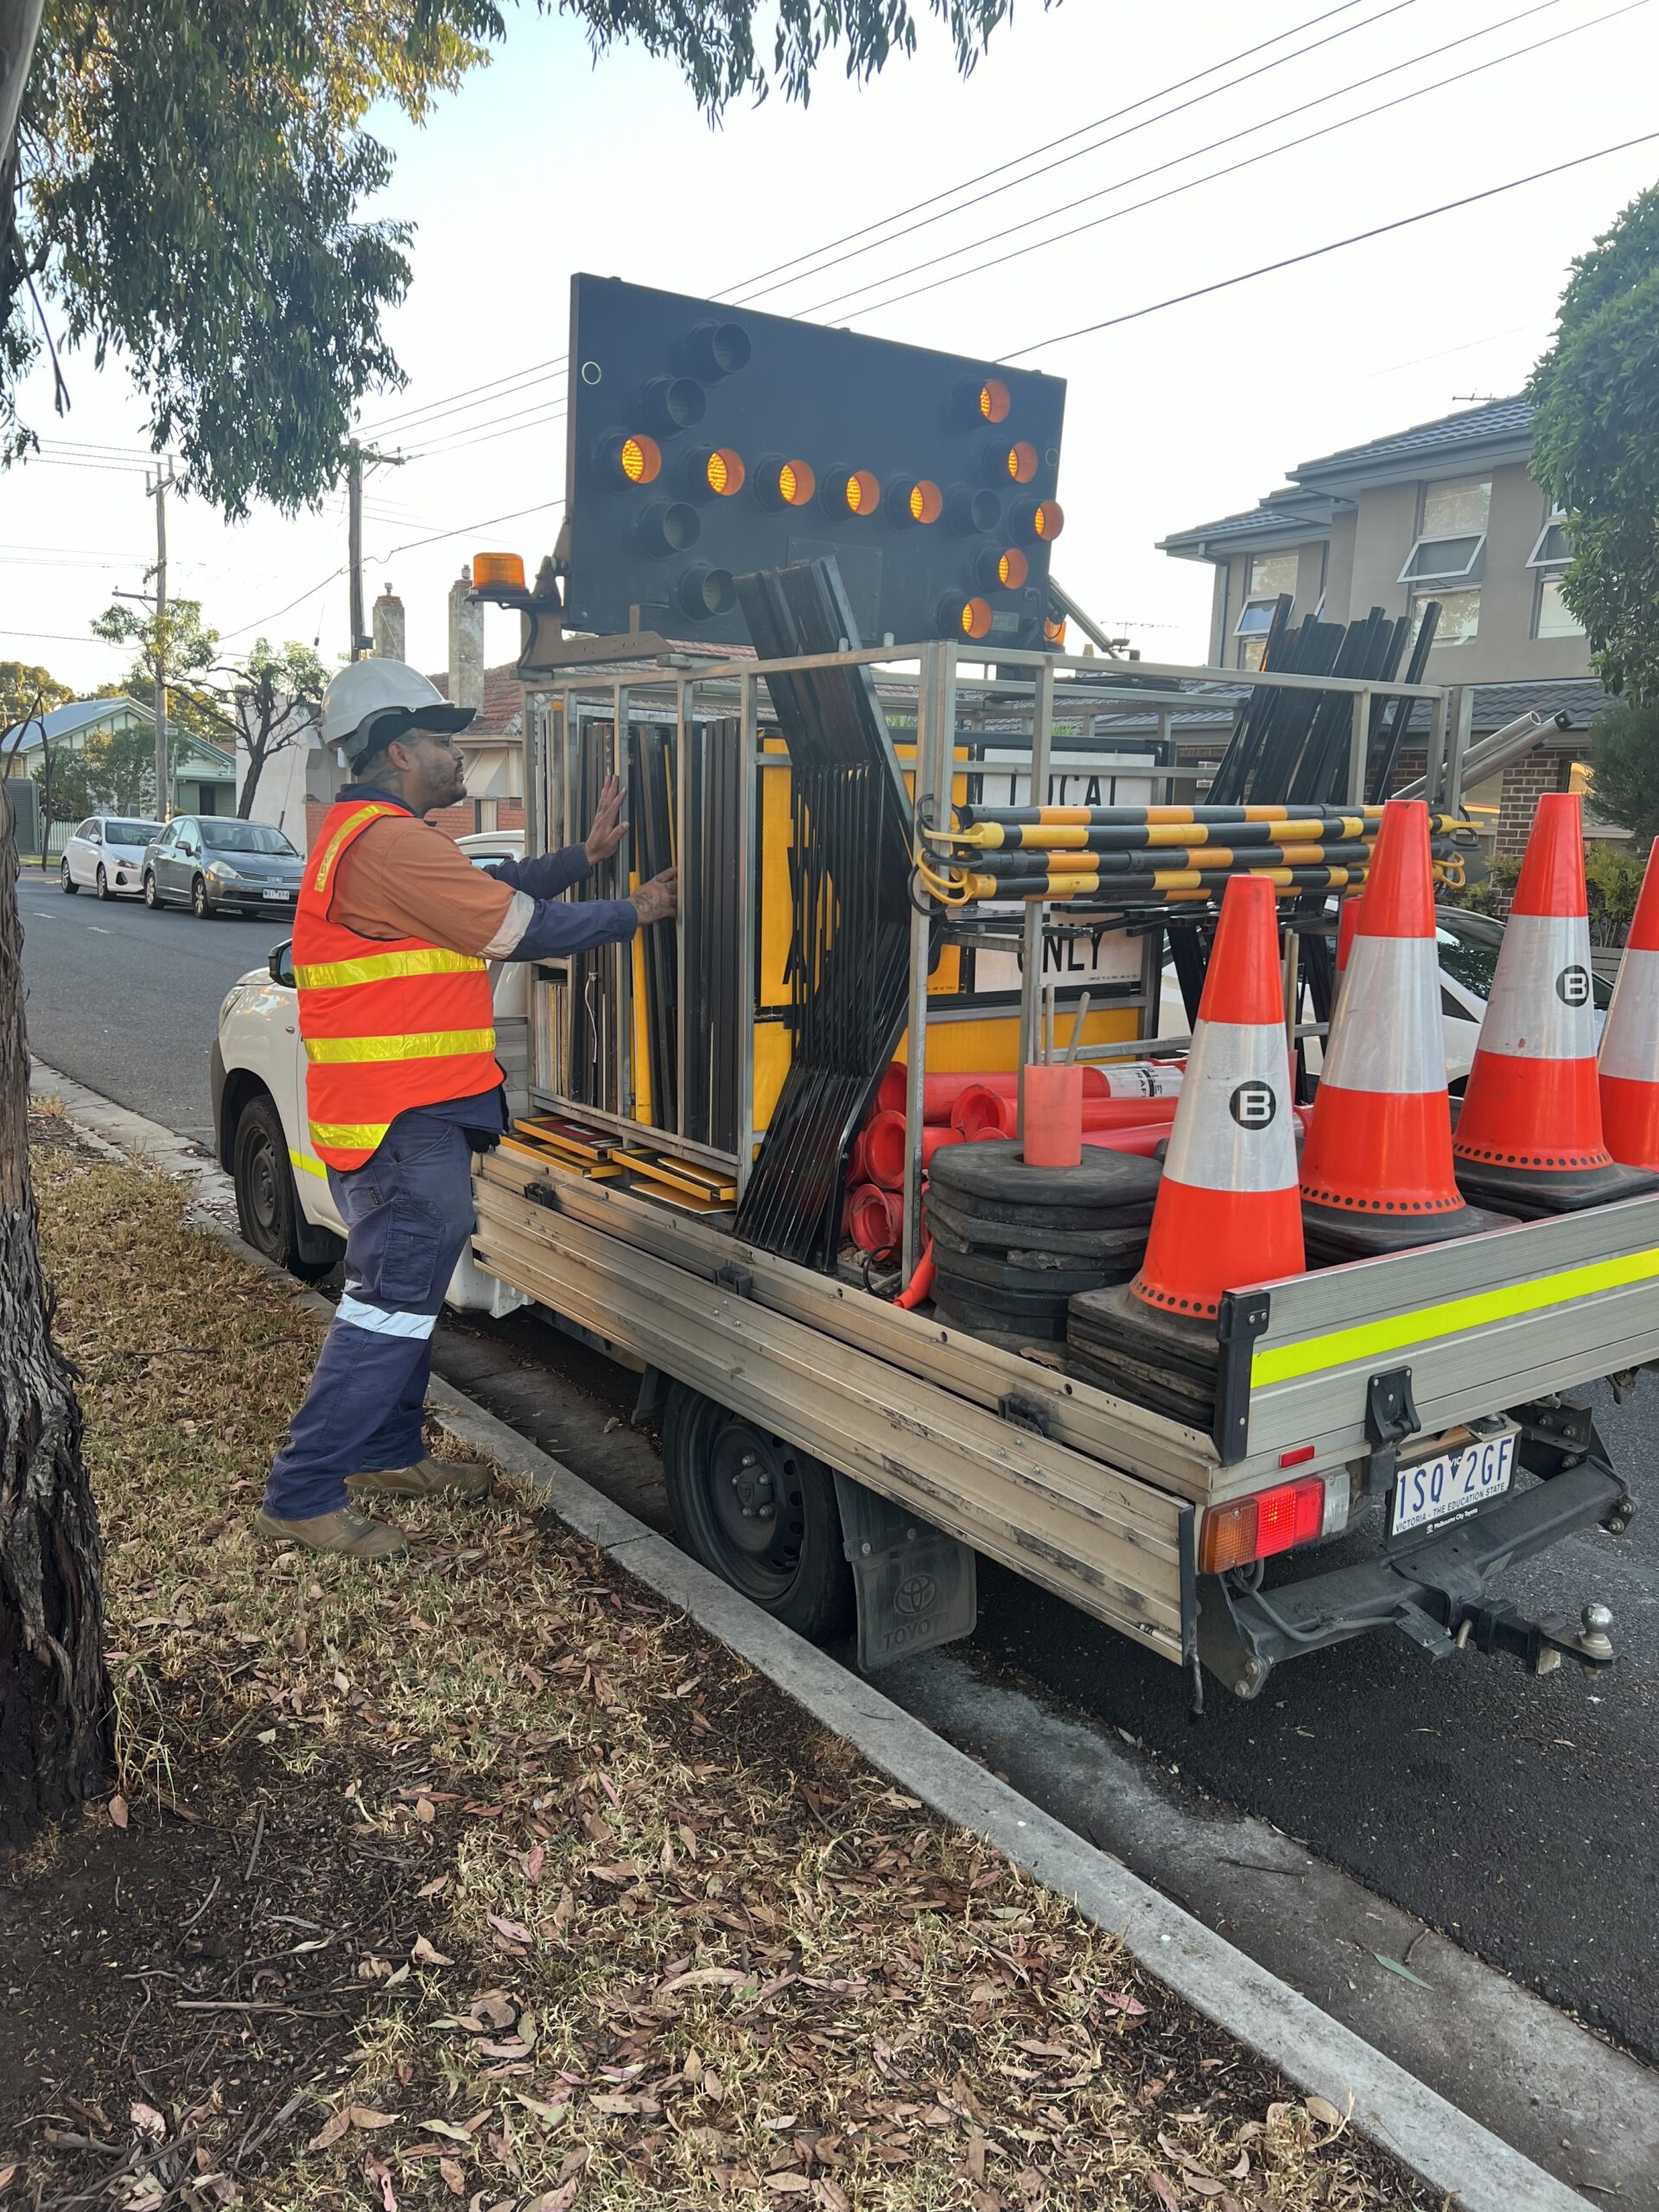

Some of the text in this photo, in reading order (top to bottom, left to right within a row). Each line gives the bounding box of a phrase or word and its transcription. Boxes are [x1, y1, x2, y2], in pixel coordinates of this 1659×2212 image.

[1564, 972, 1588, 1000] B
[1239, 1090, 1271, 1122] B
[1400, 1438, 1512, 1519] 1SQ 2GF
[1395, 1512, 1427, 1532] VICTORIA
[1433, 1504, 1446, 1516] THE
[1447, 1491, 1484, 1512] EDUCATION
[1485, 1482, 1505, 1497] STATE
[1433, 1516, 1456, 1529] Melbourne
[1464, 1508, 1478, 1517] Toyota
